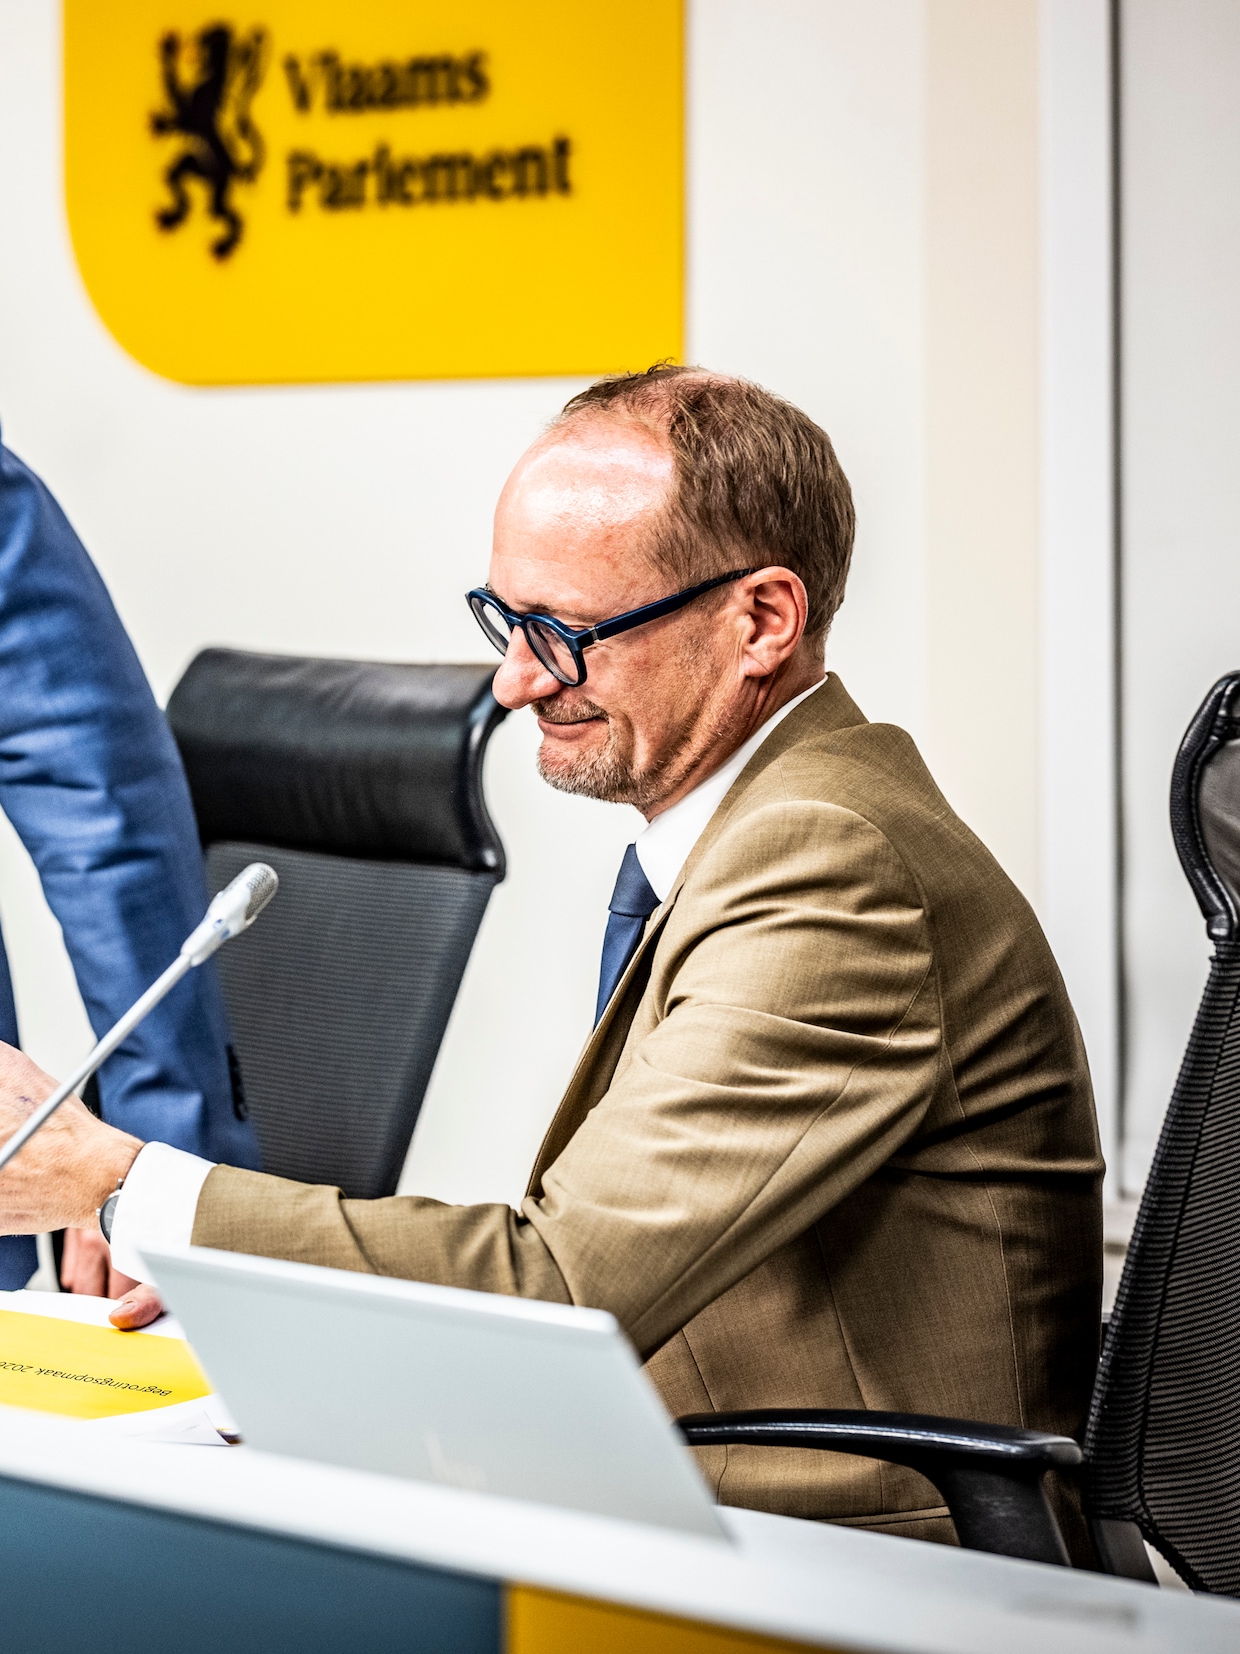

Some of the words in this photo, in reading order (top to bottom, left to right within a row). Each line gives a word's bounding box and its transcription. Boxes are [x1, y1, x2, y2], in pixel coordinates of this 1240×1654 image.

[284, 50, 490, 115] Vlaams
[286, 136, 572, 214] Parlement
[36, 1367, 172, 1397] Begrotingsopmaak
